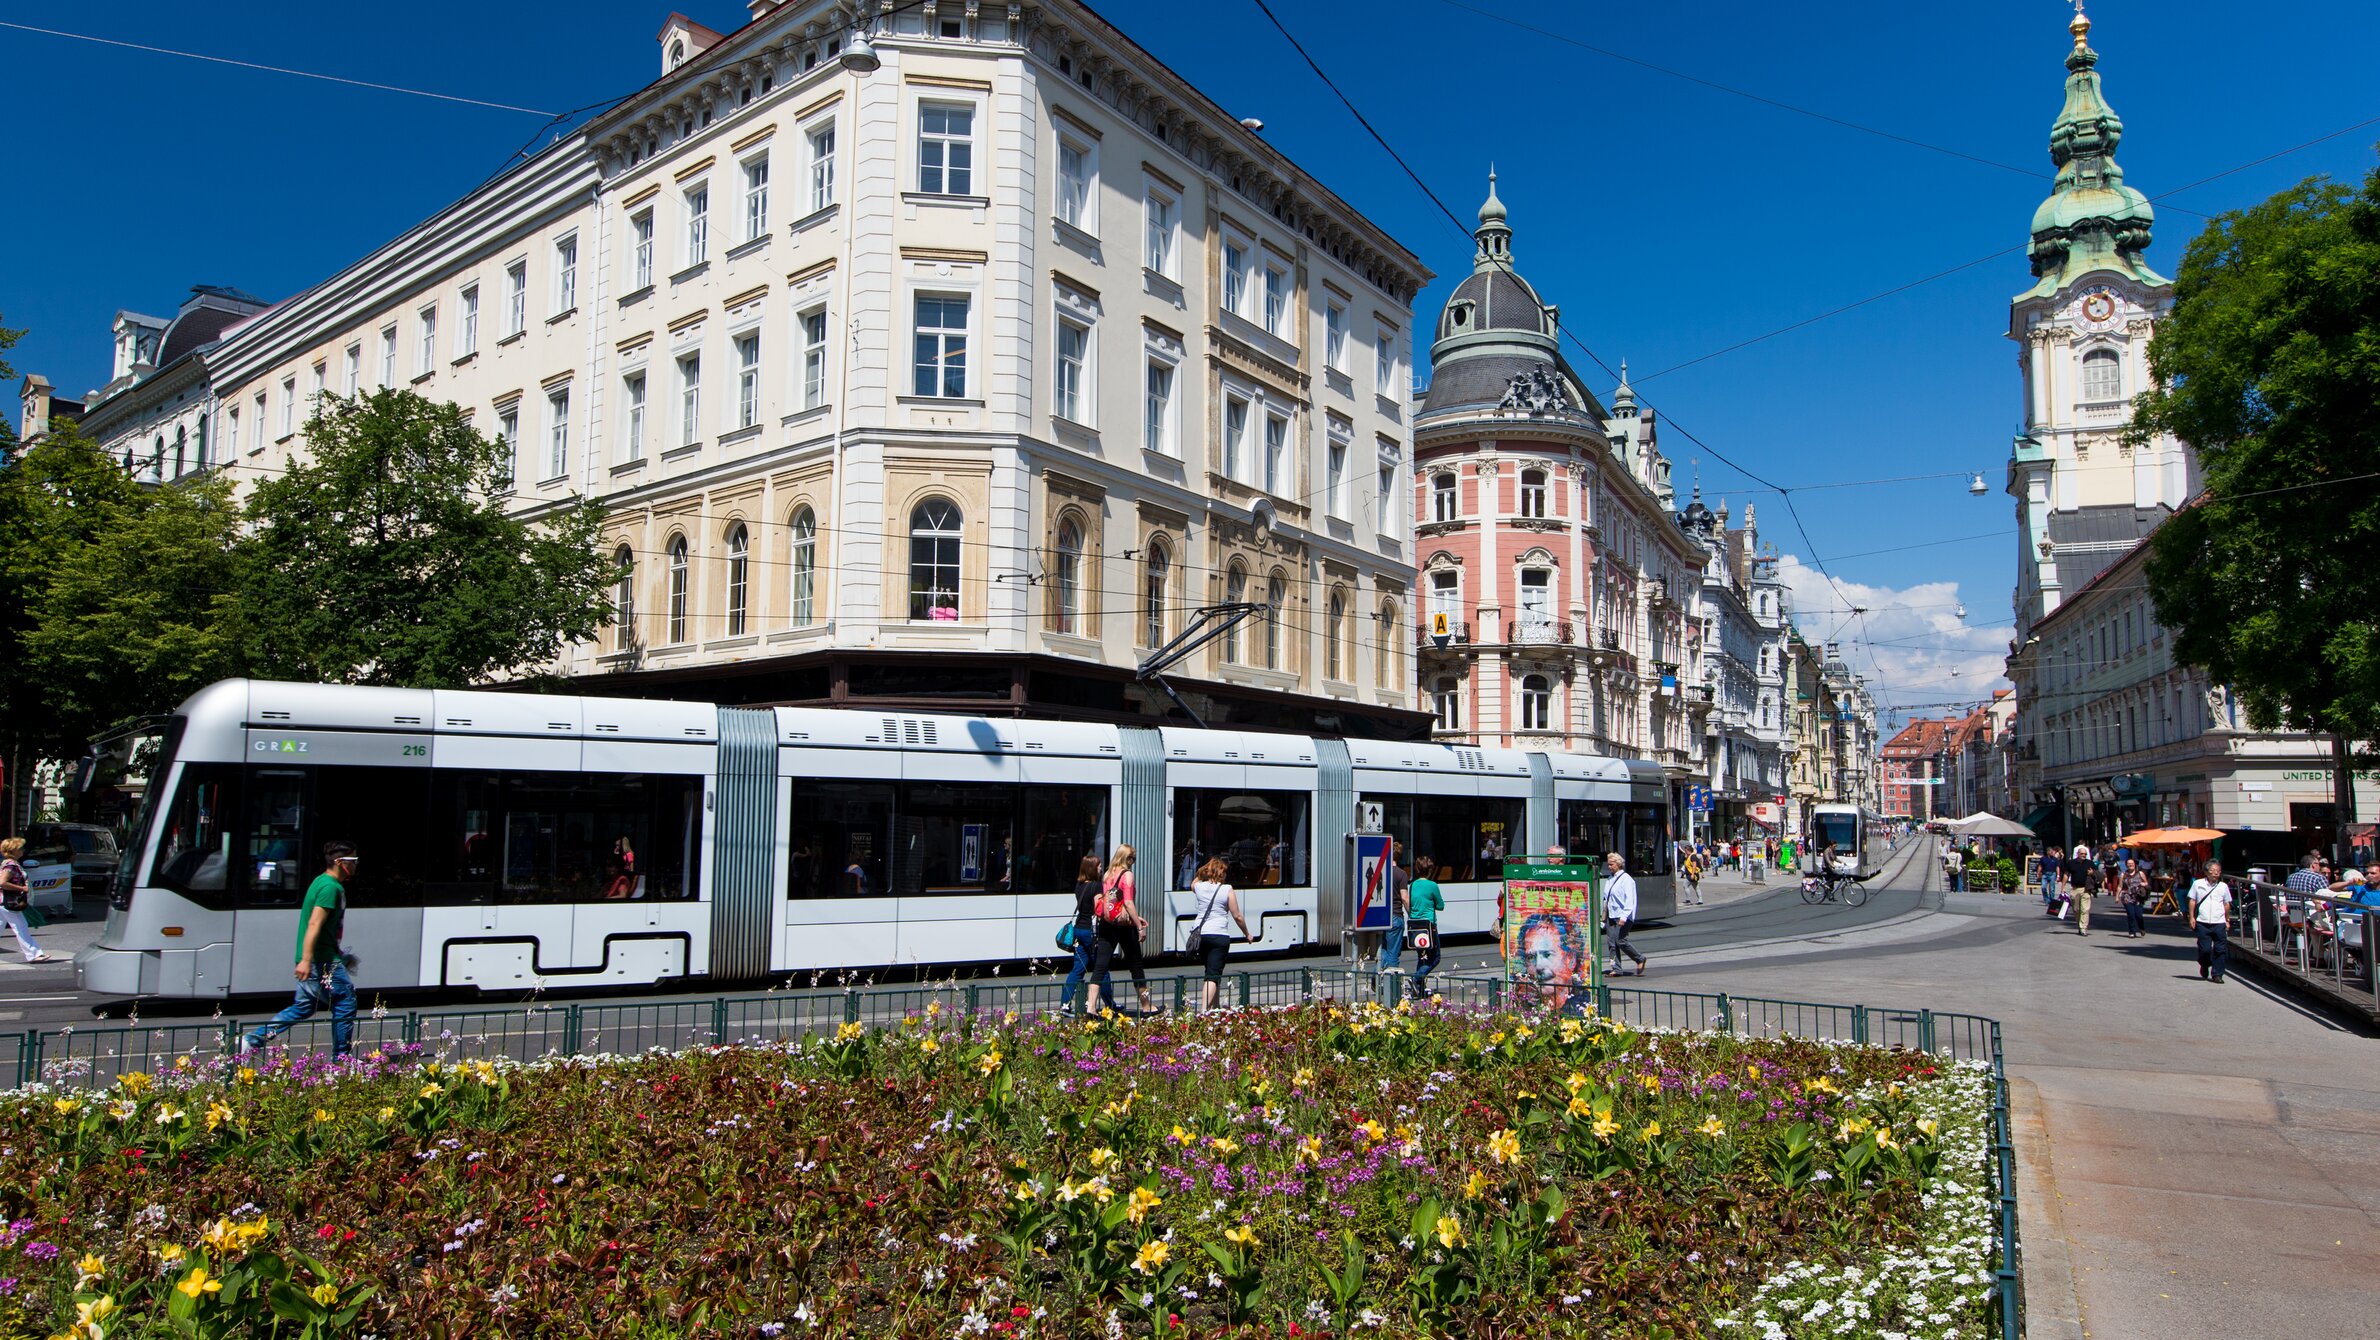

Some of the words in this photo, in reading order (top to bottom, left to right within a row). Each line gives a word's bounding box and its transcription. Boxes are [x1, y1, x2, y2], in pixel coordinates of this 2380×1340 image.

[1436, 615, 1446, 632] A
[254, 741, 307, 751] GRAZ
[402, 745, 426, 756] 216
[2282, 772, 2323, 780] UNITED
[1510, 887, 1587, 910] TESTA
